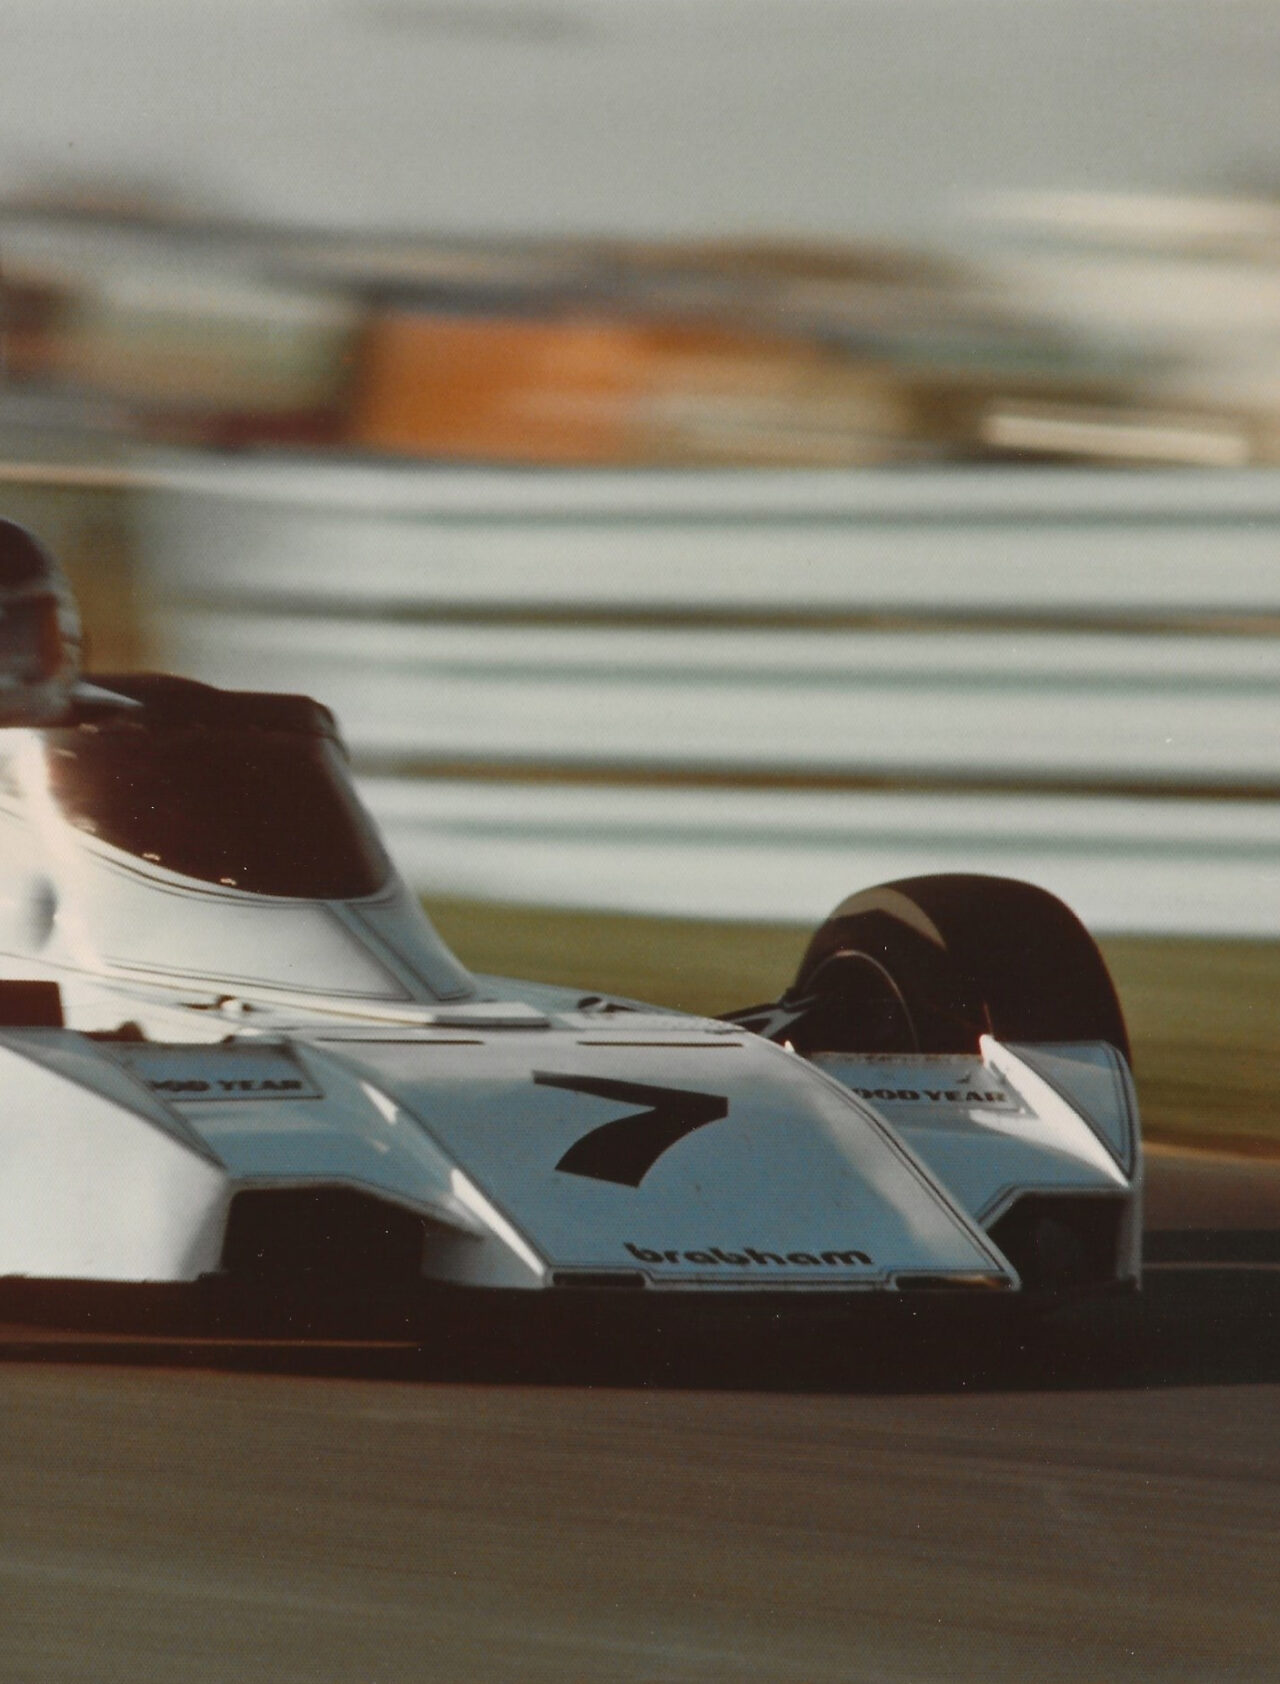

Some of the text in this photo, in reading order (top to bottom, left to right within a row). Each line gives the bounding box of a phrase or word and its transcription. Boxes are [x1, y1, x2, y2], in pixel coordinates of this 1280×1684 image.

[150, 1080, 303, 1092] OOD YEAR
[851, 1088, 1007, 1103] OOD YEAR
[531, 1070, 729, 1189] 7
[623, 1242, 874, 1267] brabham
